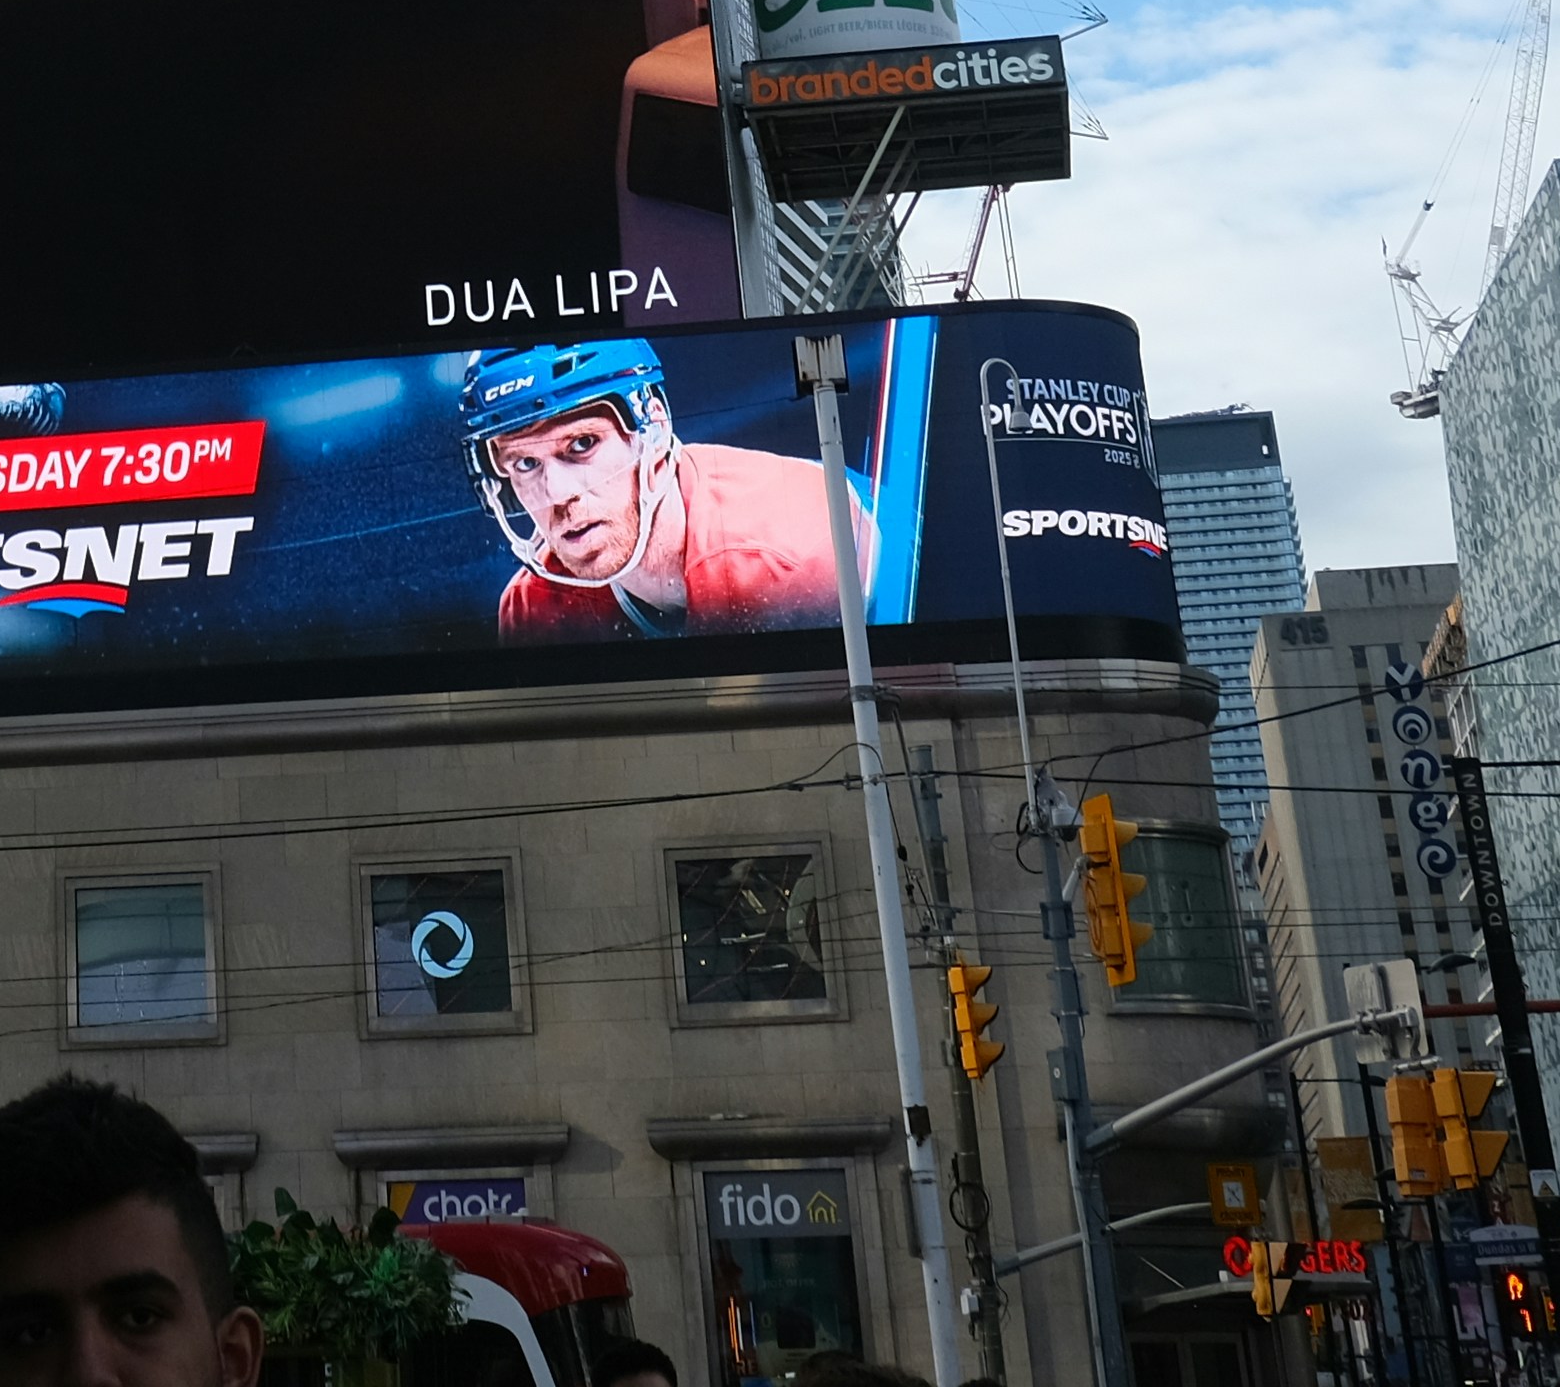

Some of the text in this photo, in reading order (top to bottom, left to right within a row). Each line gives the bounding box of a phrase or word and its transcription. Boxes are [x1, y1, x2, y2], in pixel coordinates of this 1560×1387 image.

[750, 47, 1054, 105] brandedcities
[424, 265, 680, 326] DUA LIPA
[484, 374, 535, 402] CCM
[1005, 378, 1131, 409] STANLEY CUP
[980, 402, 1137, 444] PLAYOFFS
[1104, 448, 1132, 466] 2025
[1281, 616, 1329, 645] 415
[1387, 662, 1455, 877] Yonge
[1461, 773, 1504, 927] DOWNTOWN
[719, 1183, 801, 1227] fido
[1298, 1238, 1368, 1274] GERS
